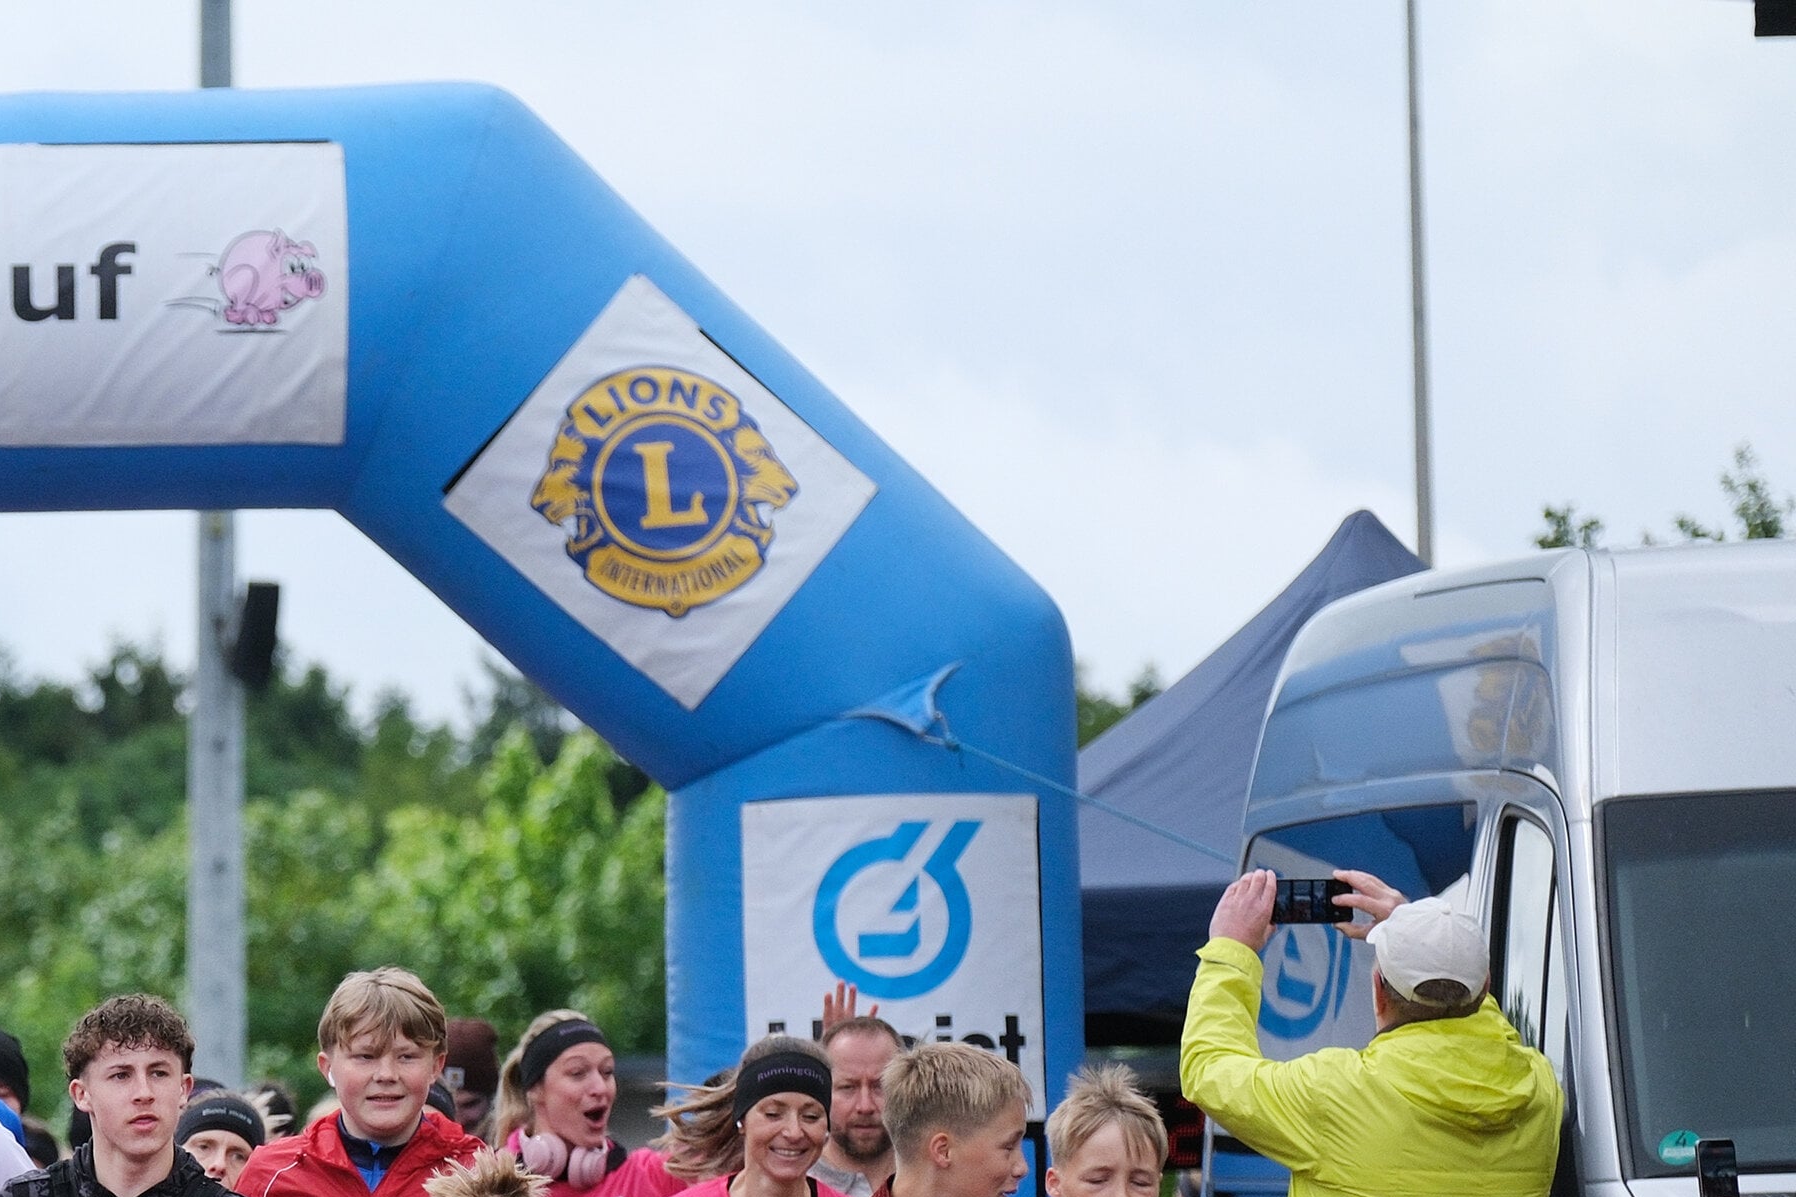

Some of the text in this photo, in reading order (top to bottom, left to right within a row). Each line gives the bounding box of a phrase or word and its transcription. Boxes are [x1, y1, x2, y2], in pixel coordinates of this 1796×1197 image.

[583, 376, 727, 428] LIONS
[633, 441, 708, 529] L
[601, 549, 749, 596] INTERNATIONAL
